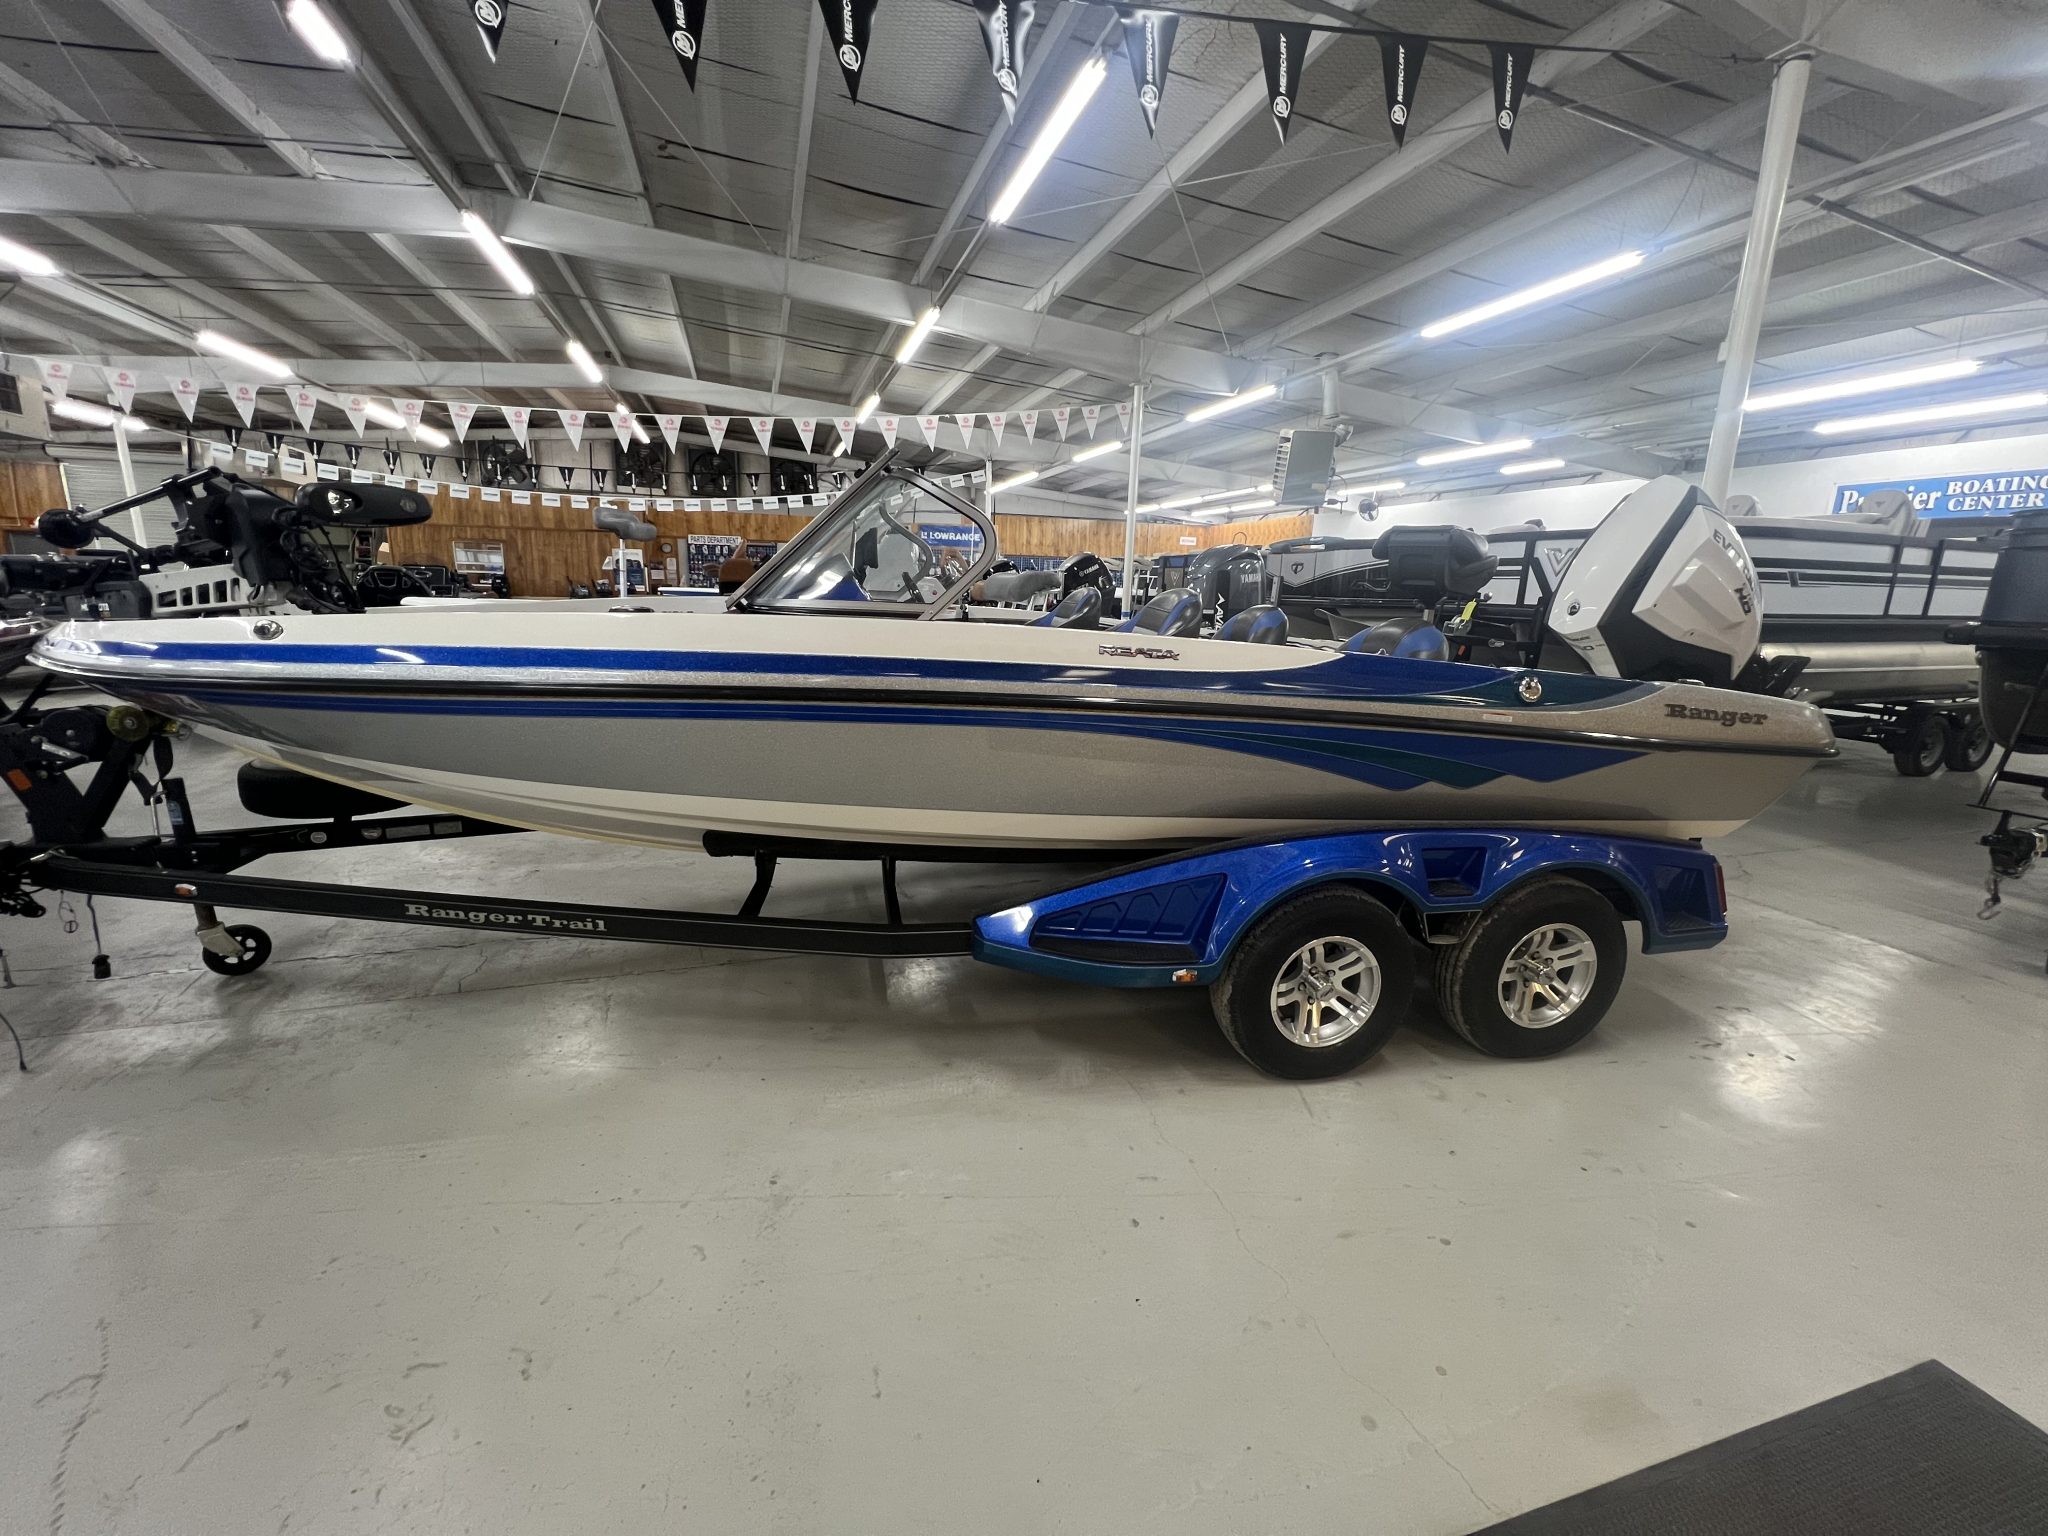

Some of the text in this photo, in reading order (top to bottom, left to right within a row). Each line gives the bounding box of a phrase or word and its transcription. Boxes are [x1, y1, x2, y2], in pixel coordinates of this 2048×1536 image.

[1146, 18, 1154, 83] MERCURY
[1279, 32, 1287, 94] MERCURY
[1396, 44, 1405, 102] MERCURY
[1504, 52, 1513, 108] MERCURY
[1947, 492, 2045, 512] CENTER
[690, 535, 739, 545] PARTS DEPARTMENT
[929, 531, 981, 541] LOWRANCE
[1098, 644, 1180, 661] REATA
[1664, 703, 1768, 727] Ranger
